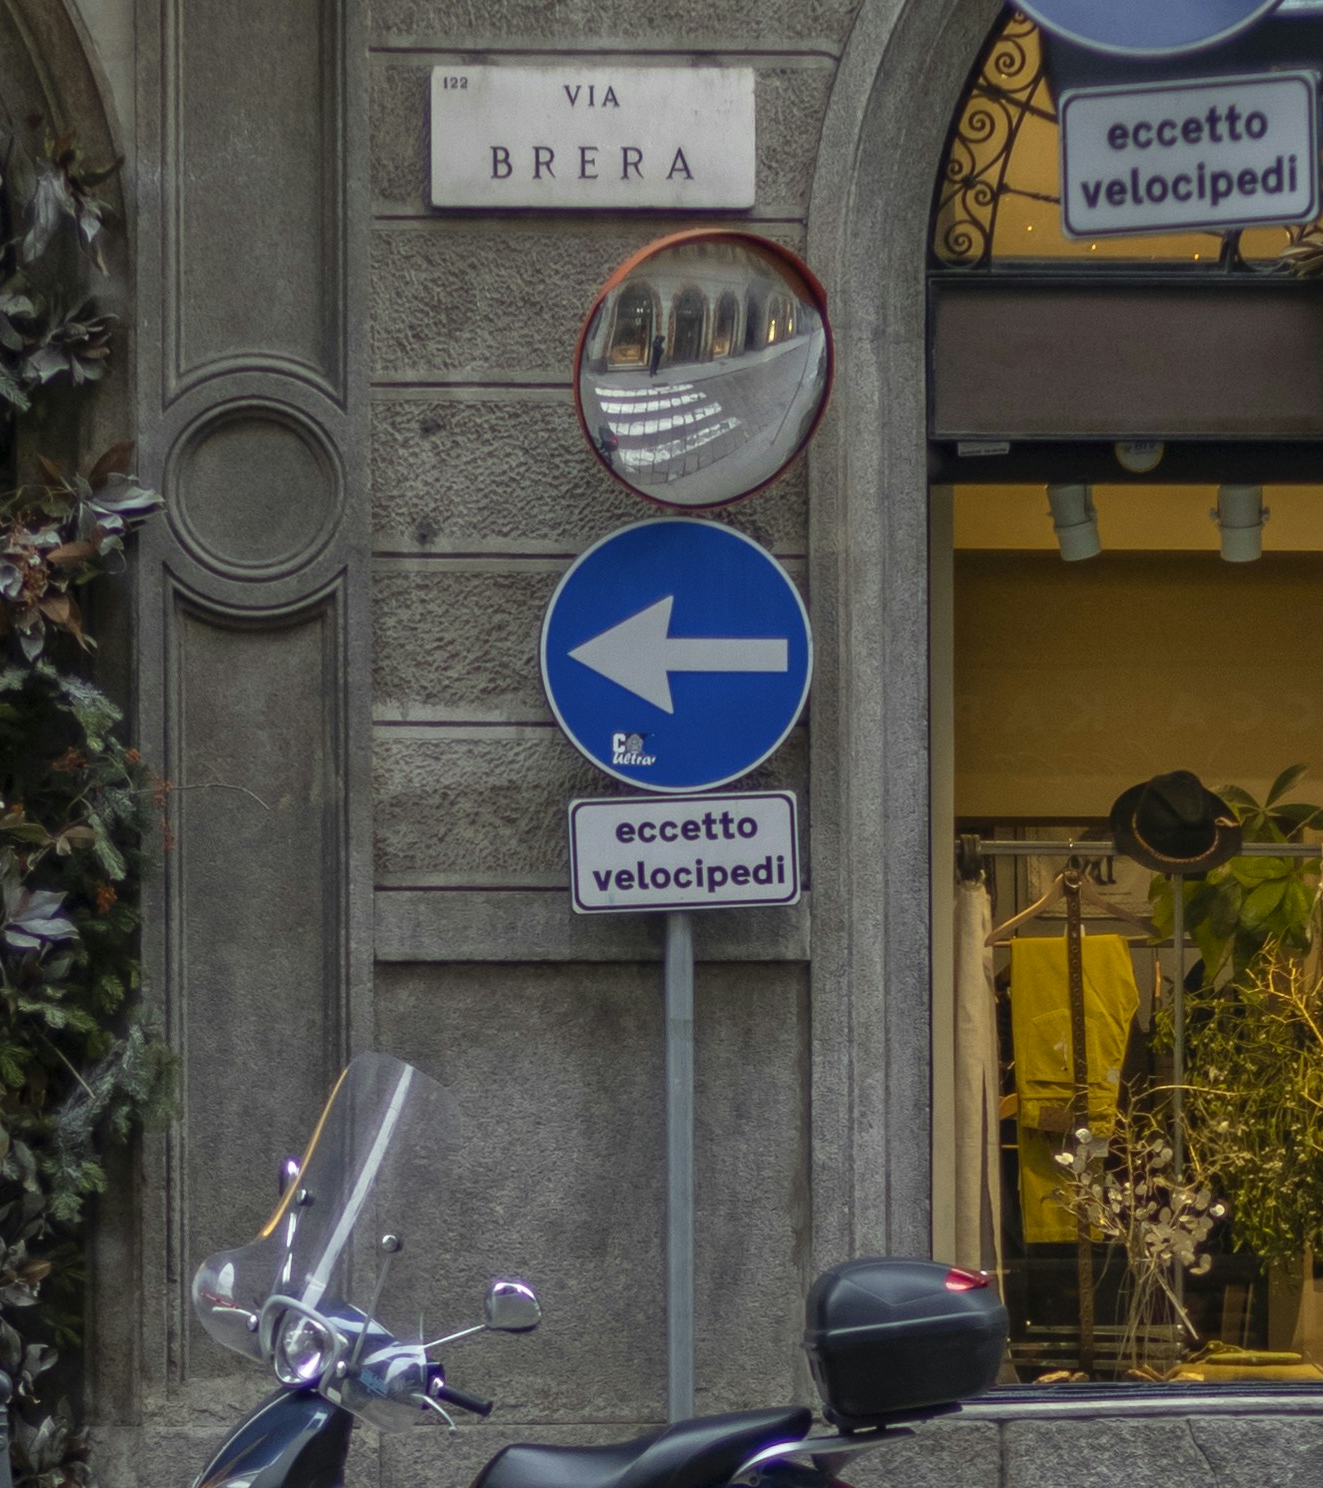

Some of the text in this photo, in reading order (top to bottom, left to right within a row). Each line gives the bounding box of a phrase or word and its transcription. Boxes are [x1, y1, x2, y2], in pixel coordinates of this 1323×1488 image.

[443, 76, 469, 89] 122
[563, 85, 620, 108] VIA
[1106, 104, 1269, 150] eccetto
[489, 145, 695, 181] BRERA
[1080, 154, 1298, 209] velocipedi
[615, 811, 759, 844] eccetto
[592, 855, 786, 893] velocipedi
